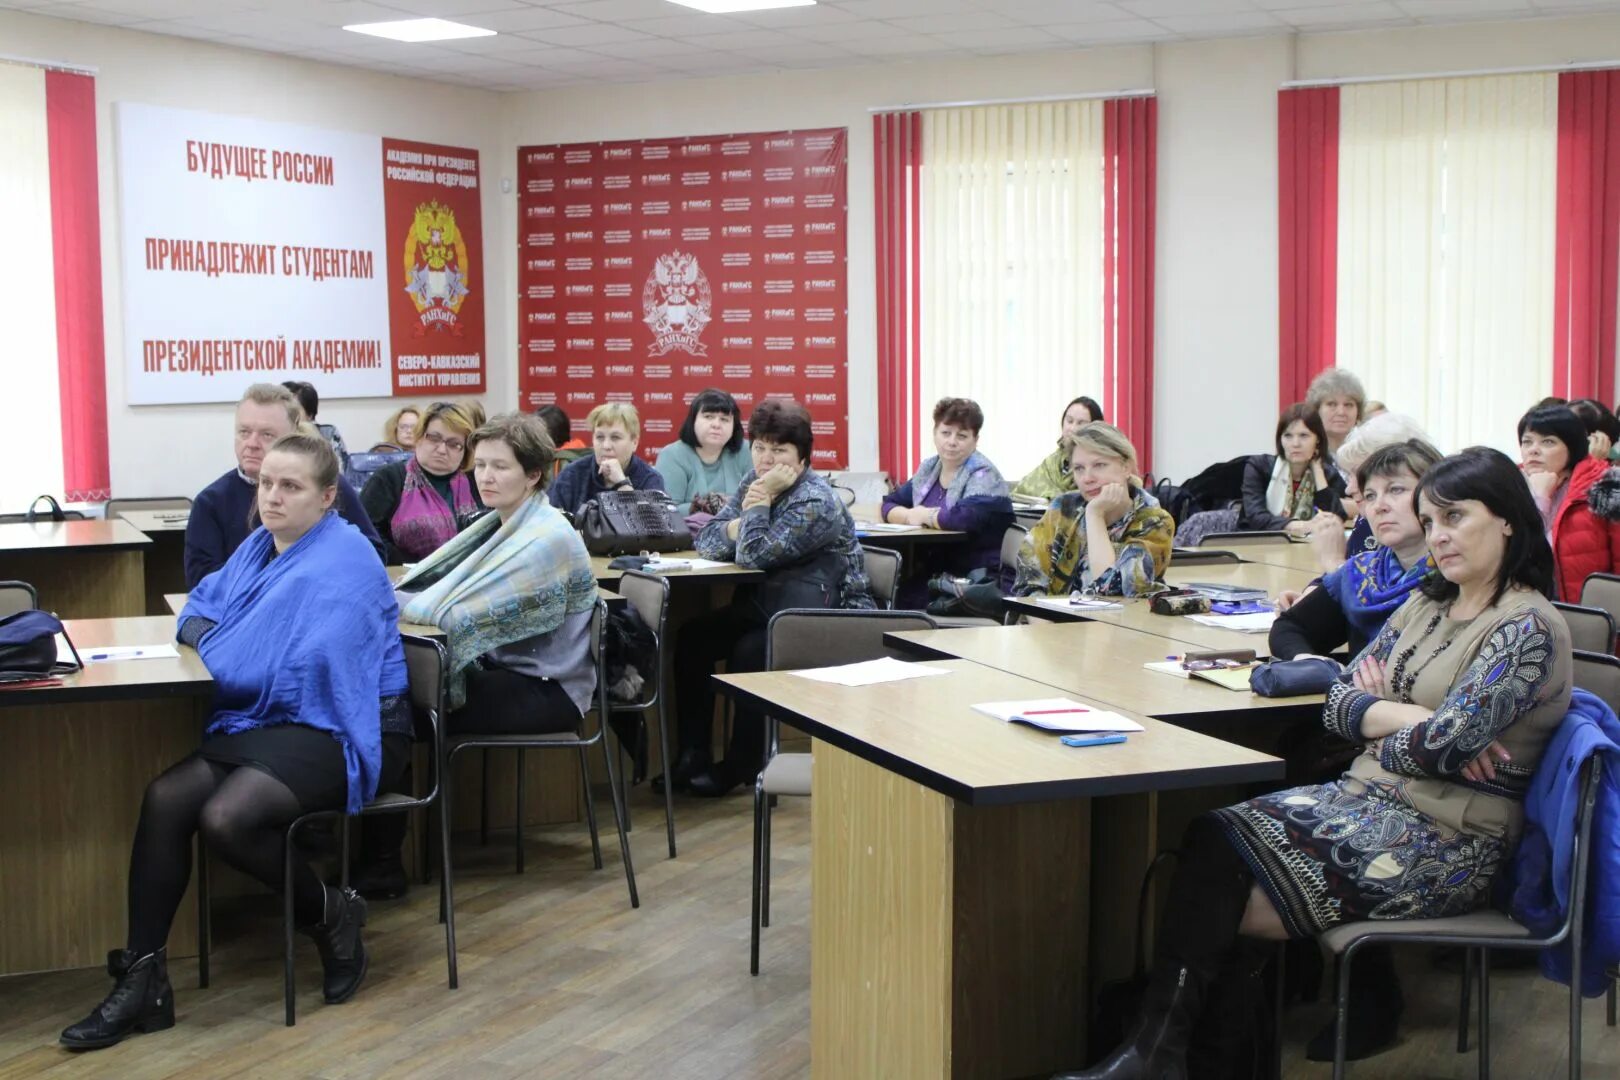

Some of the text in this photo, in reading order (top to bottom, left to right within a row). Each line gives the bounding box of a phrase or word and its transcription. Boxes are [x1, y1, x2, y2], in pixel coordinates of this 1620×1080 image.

[187, 140, 334, 186] БУДУЩЕЕ РОССИИ
[387, 149, 475, 170] АКАДЕМИЯ ПРИ ПРЕЗИДЕНТЕ
[387, 167, 477, 189] РОССИЙСКОЙ ФЕДЕРАЦИИ
[145, 238, 373, 281] ПРИНАДЛЕЖИТ СТУДЕНТАМ
[657, 333, 697, 348] РАНХиГС
[143, 336, 381, 375] ПРЕЗИДЕНТСКОЙ АКАДЕМИИ!
[398, 353, 480, 369] СЕВЕРО-КАВКАЗСКИЙ
[399, 373, 481, 387] ИНСТИТУТ УПРАВЛЕНИЯ
